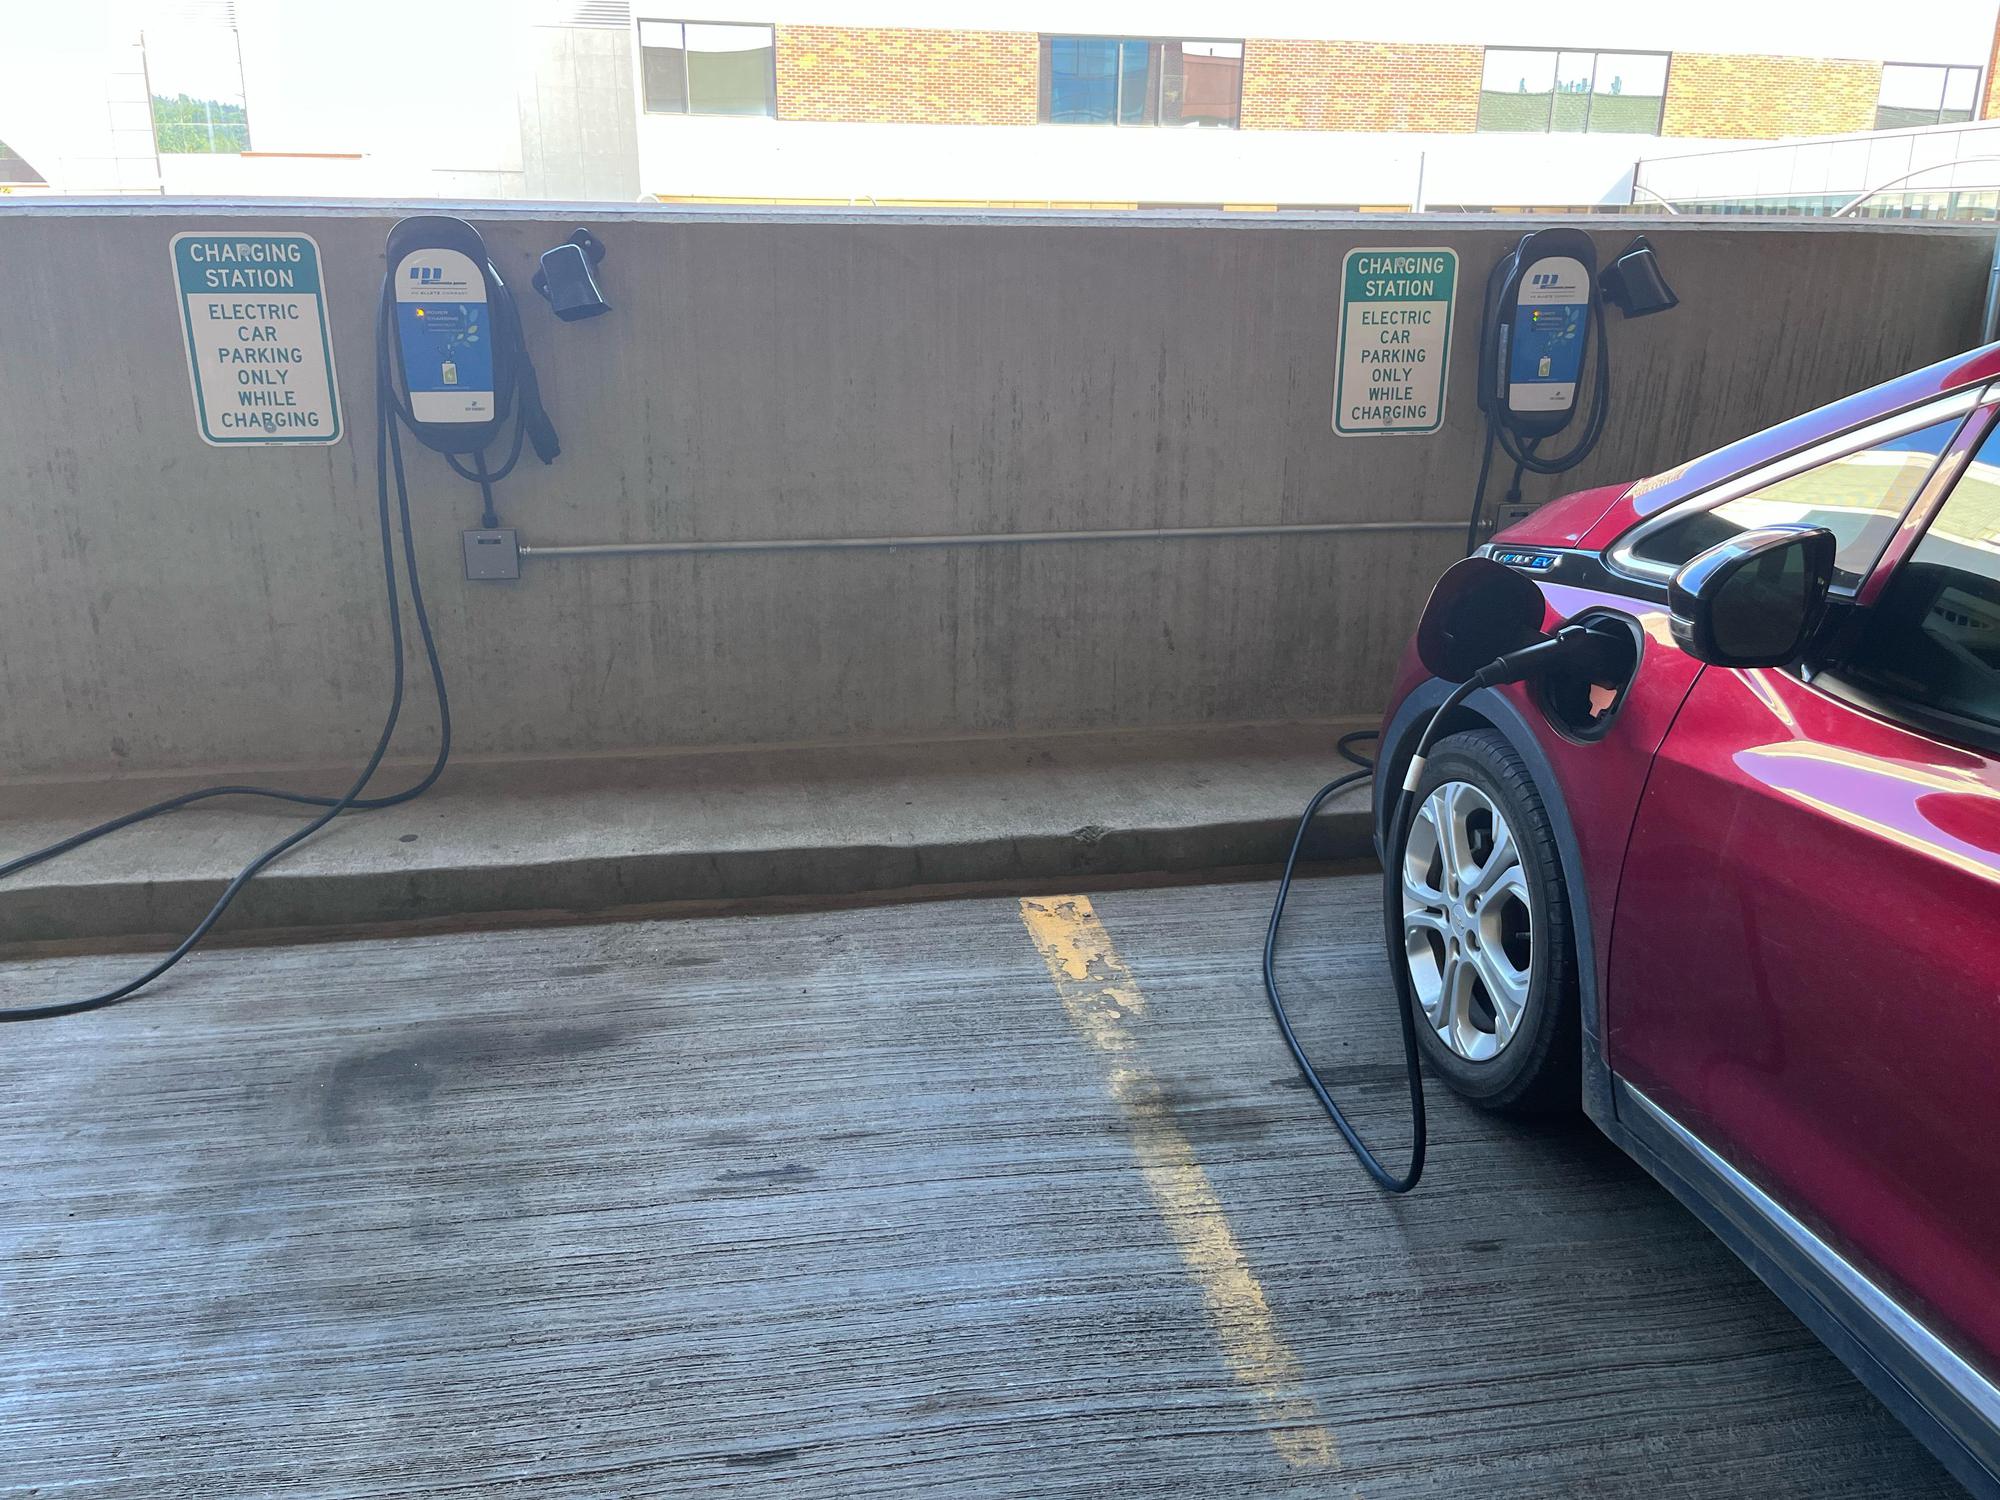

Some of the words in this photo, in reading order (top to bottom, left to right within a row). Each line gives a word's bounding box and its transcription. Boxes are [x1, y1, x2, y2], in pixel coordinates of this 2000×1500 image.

[190, 243, 301, 262] CHARGING
[1358, 257, 1444, 274] CHARGING
[205, 269, 294, 288] STATION
[1365, 280, 1434, 297] STATION
[208, 303, 300, 320] ELECTRIC
[1361, 310, 1432, 325] ELECTRIC
[238, 326, 278, 342] CAR
[1380, 329, 1410, 344] CAR
[218, 348, 303, 364] PARKING
[1361, 348, 1426, 363] PARKING
[238, 369, 289, 385] ONLY
[1372, 367, 1413, 382] ONLY
[238, 391, 297, 406] WHILE
[1369, 386, 1413, 401] WHILE
[221, 412, 320, 428] CHARGING
[1351, 405, 1427, 420] CHARGING
[1531, 556, 1554, 568] EV
